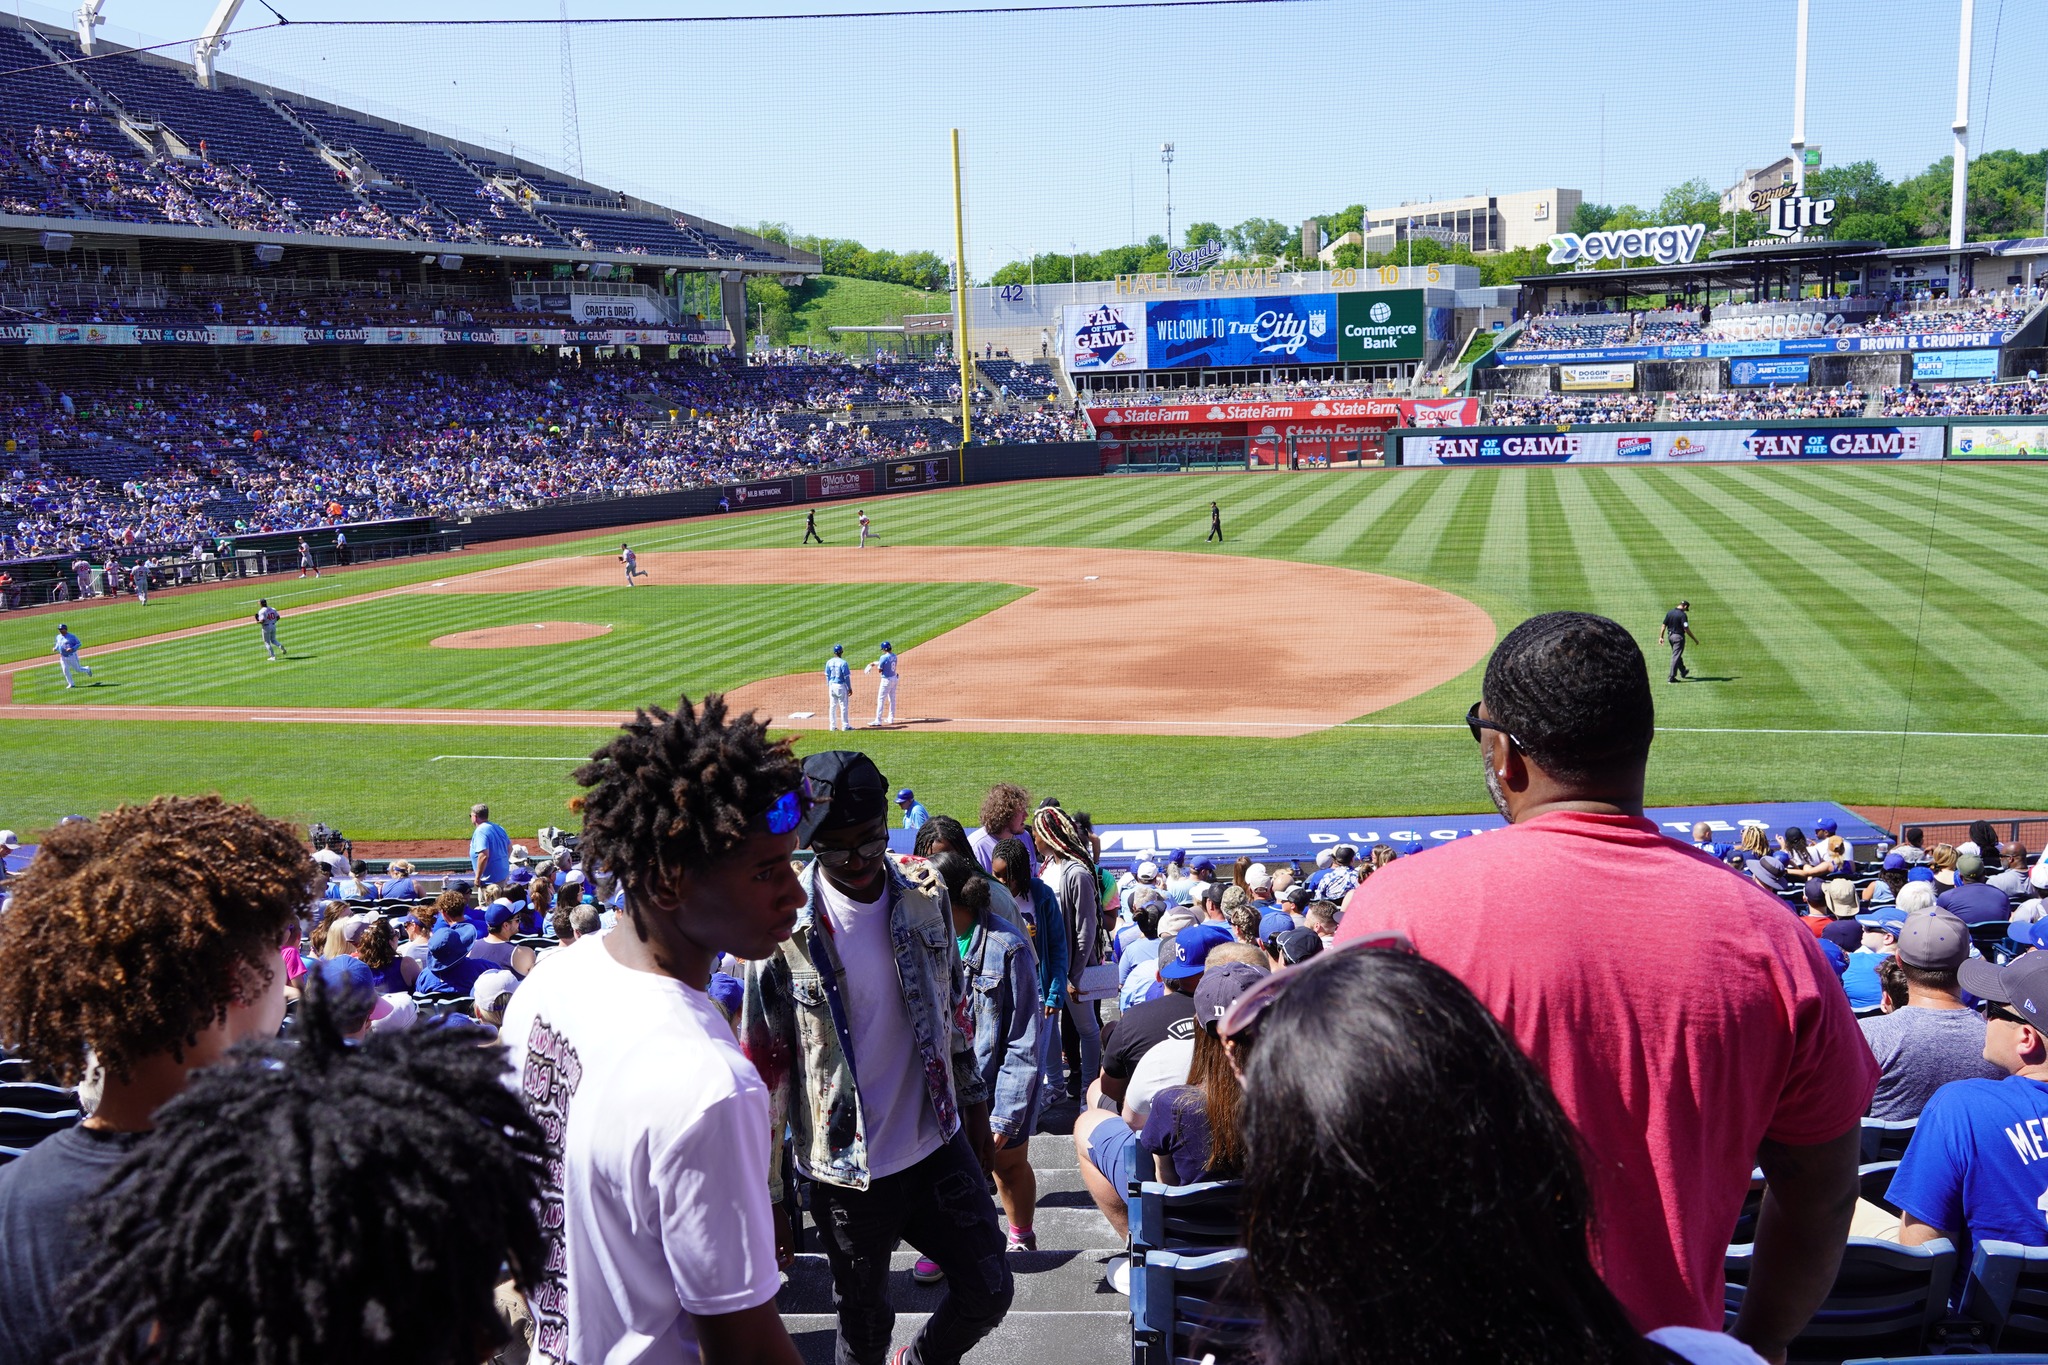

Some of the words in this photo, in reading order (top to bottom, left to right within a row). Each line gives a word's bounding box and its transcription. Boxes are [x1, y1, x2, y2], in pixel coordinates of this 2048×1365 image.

[1749, 183, 1797, 211] Miller
[1766, 196, 1836, 237] Lite
[1583, 224, 1705, 263] evergy
[1168, 239, 1224, 273] Royals
[1331, 268, 1357, 287] 20
[1377, 265, 1399, 284] 10
[1427, 263, 1440, 282] 5
[1114, 272, 1181, 294] HALL
[1186, 273, 1208, 295] of
[1209, 267, 1280, 291] FAME
[1000, 284, 1024, 302] 42
[586, 305, 606, 316] CRAFT
[608, 305, 614, 316] &
[614, 306, 634, 317] DRAFT
[1082, 307, 1124, 326] FAN
[1157, 319, 1207, 341] WELCOME
[1212, 318, 1225, 338] TO
[1228, 321, 1259, 335] THE
[1251, 310, 1308, 354] City
[1311, 318, 1324, 333] KC
[1345, 324, 1416, 337] Commerce
[134, 328, 162, 340] FAN
[176, 330, 217, 342] GAME
[302, 330, 324, 340] FAN
[336, 330, 370, 340] GAME
[442, 332, 461, 340] FAN
[471, 332, 500, 342] GAME
[562, 332, 578, 340] FAN
[587, 332, 612, 340] GAME
[666, 332, 680, 342] FAN
[688, 333, 710, 342] GAME
[1074, 328, 1137, 350] GAME
[1860, 336, 1905, 350] BROWN
[1908, 336, 1919, 348] &
[1922, 333, 1992, 348] CROUPPEN
[1363, 336, 1397, 350] Bank
[1124, 408, 1190, 423] StateFarm
[1226, 405, 1293, 419] StateFarm
[1331, 400, 1397, 416] StateFarm
[1418, 410, 1458, 421] SONIC
[1556, 424, 1571, 432] 387
[1483, 438, 1498, 448] OF
[1502, 436, 1582, 456] GAME
[1620, 438, 1639, 448] PRICE
[1746, 436, 1802, 456] FAN
[1808, 436, 1824, 444] OF
[1830, 433, 1920, 454] GAME
[1429, 438, 1478, 458] FAN
[1480, 448, 1500, 456] THE
[1618, 442, 1652, 456] CHOPPER
[1669, 444, 1705, 457] Borden
[1804, 445, 1828, 454] THE
[829, 475, 845, 484] Mark
[846, 474, 860, 482] One
[748, 490, 758, 498] MLB
[758, 488, 782, 497] NETWORK
[1098, 828, 1268, 850] MB
[1308, 828, 1490, 844] DUGO
[1662, 819, 1770, 833] TES
[1176, 942, 1186, 962] KC
